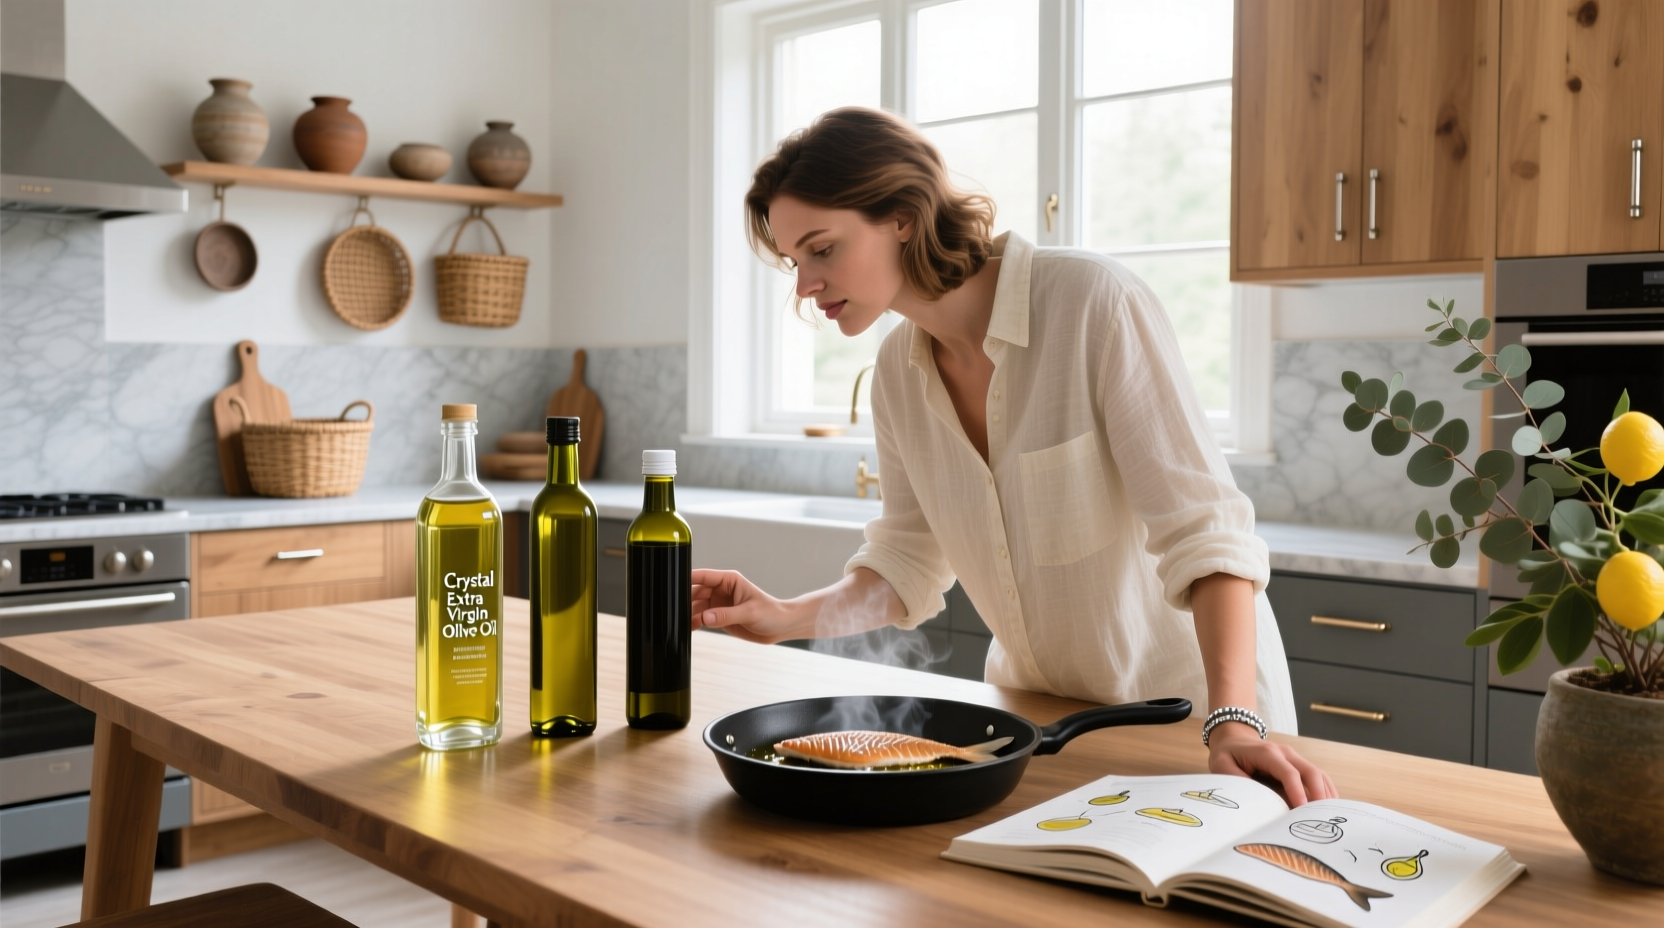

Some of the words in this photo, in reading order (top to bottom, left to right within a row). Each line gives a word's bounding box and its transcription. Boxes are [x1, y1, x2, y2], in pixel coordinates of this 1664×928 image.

[444, 570, 494, 592] Crystal
[447, 592, 483, 606] Extra
[447, 606, 488, 624] Virgin
[442, 623, 477, 638] Olive
